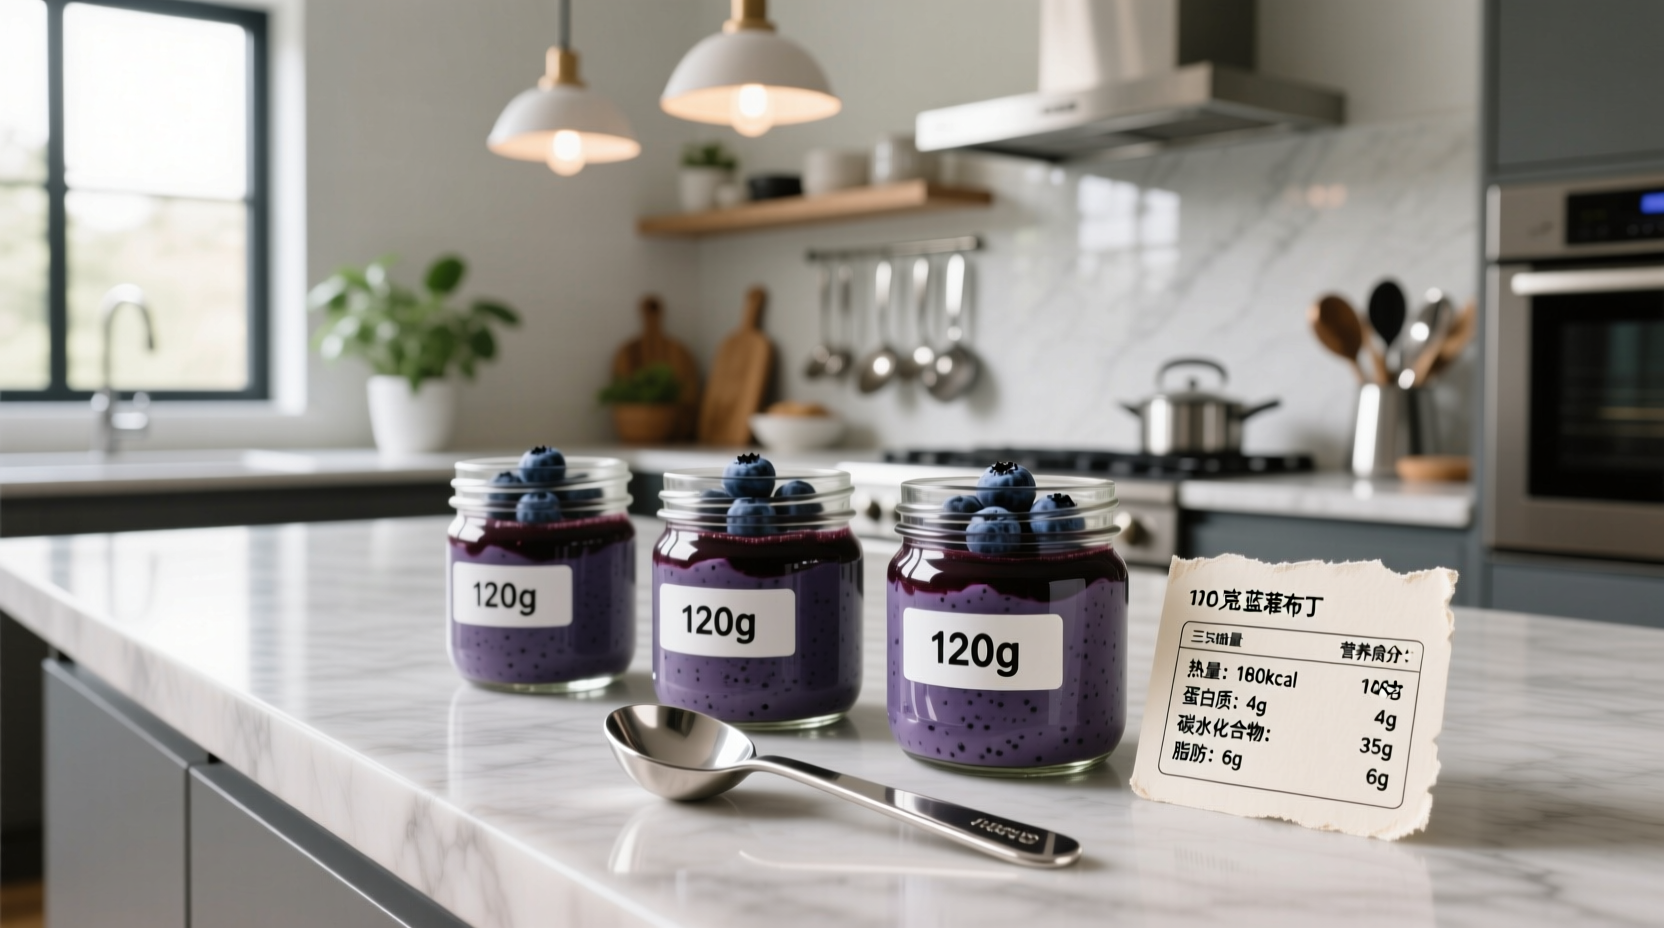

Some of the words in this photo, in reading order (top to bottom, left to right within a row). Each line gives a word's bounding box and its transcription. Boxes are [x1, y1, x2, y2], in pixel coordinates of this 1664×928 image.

[473, 581, 537, 616] 120g
[682, 604, 756, 644] 120g
[931, 630, 1020, 678] 120g
[1246, 695, 1268, 717] 4g
[1374, 709, 1398, 732] 4g
[1221, 749, 1243, 771] 6g
[1359, 737, 1394, 762] 35g
[1366, 768, 1390, 792] 6g
